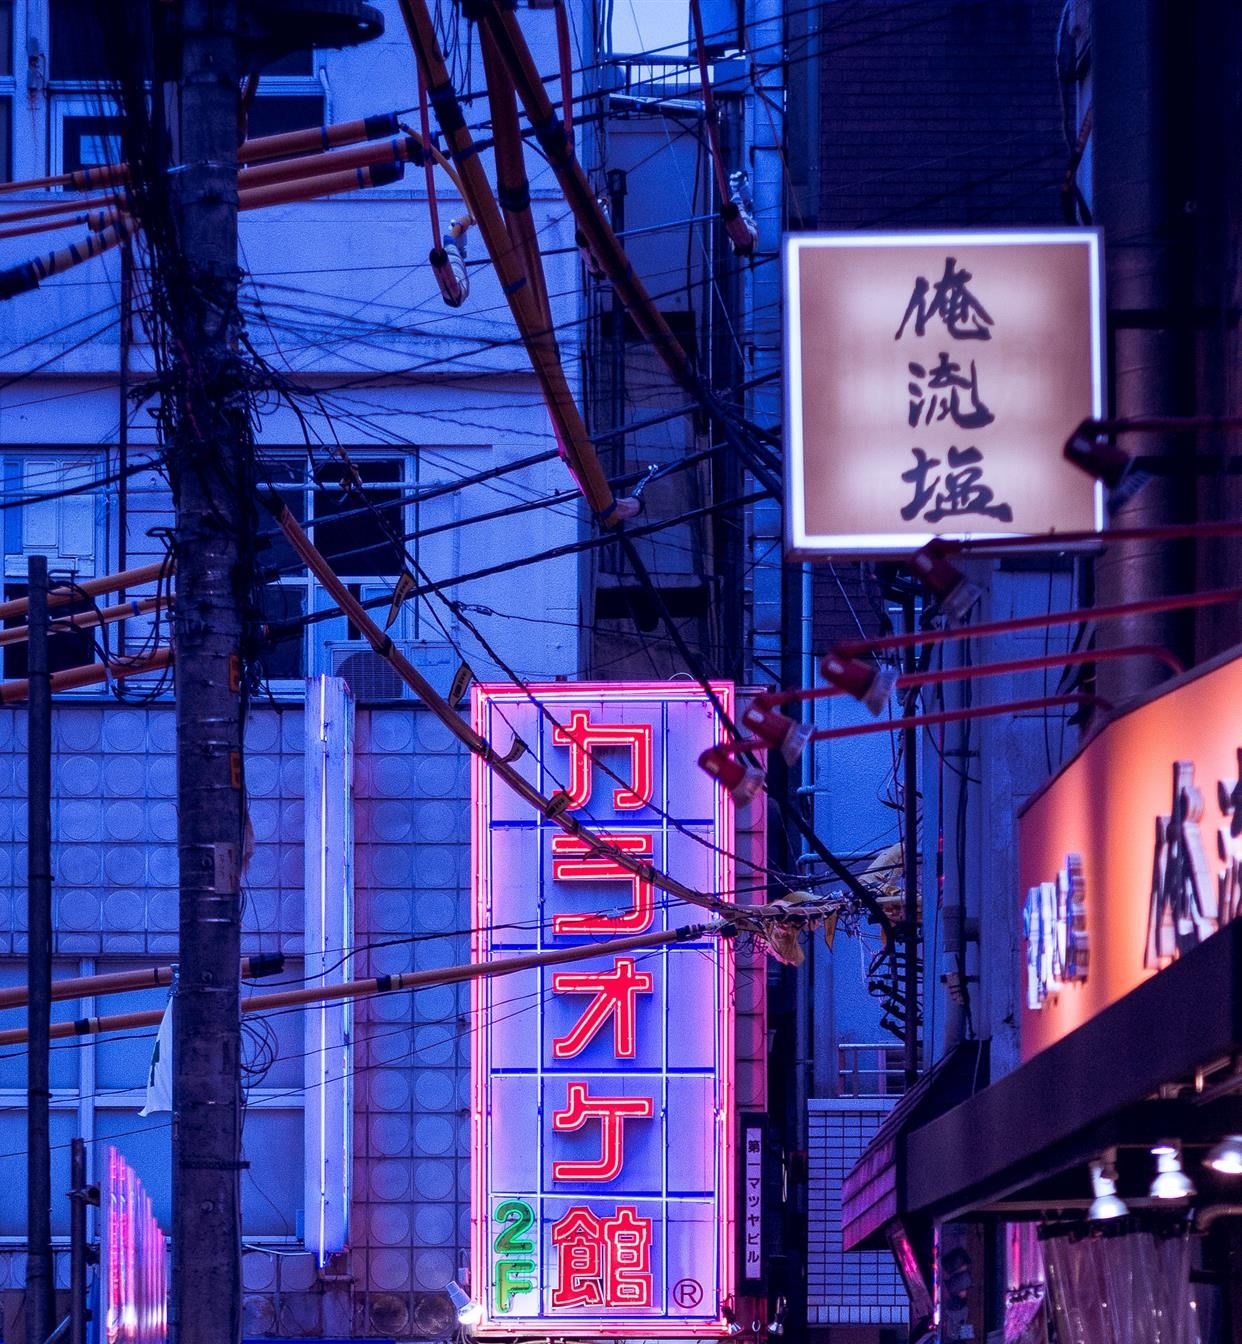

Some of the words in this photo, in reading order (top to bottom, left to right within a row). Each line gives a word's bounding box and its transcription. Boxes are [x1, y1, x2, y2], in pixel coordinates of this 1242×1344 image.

[895, 257, 1013, 524] 俺流塩
[551, 709, 654, 1309] カラオケ館
[495, 1199, 536, 1314] 2F
[748, 1140, 760, 1263] 第一マツヤビル
